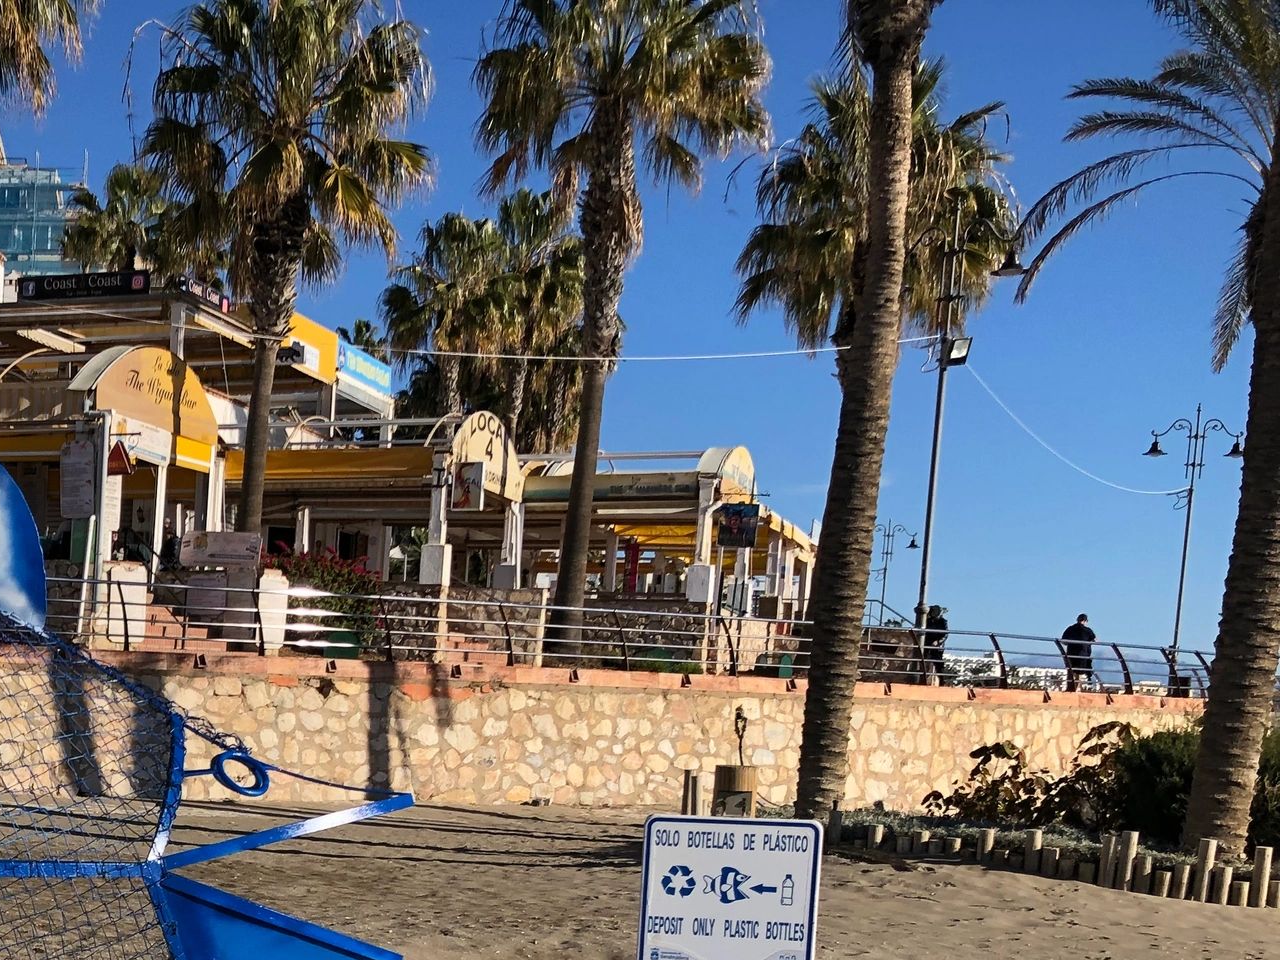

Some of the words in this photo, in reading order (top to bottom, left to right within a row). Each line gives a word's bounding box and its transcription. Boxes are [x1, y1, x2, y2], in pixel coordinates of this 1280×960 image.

[43, 276, 77, 290] Coast
[88, 273, 122, 288] Coast
[125, 369, 144, 392] The
[147, 377, 176, 404] Wigan
[179, 391, 197, 409] Bar
[470, 412, 504, 446] LOCA
[485, 437, 494, 461] 4
[655, 829, 680, 847] SOLO
[687, 831, 735, 850] BOTELLAS
[743, 833, 756, 851] DE
[763, 830, 808, 853] PLÁSTICO
[648, 916, 684, 935] DEPOSIT
[692, 918, 716, 937] ONLY
[724, 919, 759, 939] PLASTIC
[765, 921, 805, 942] BOTTLES
